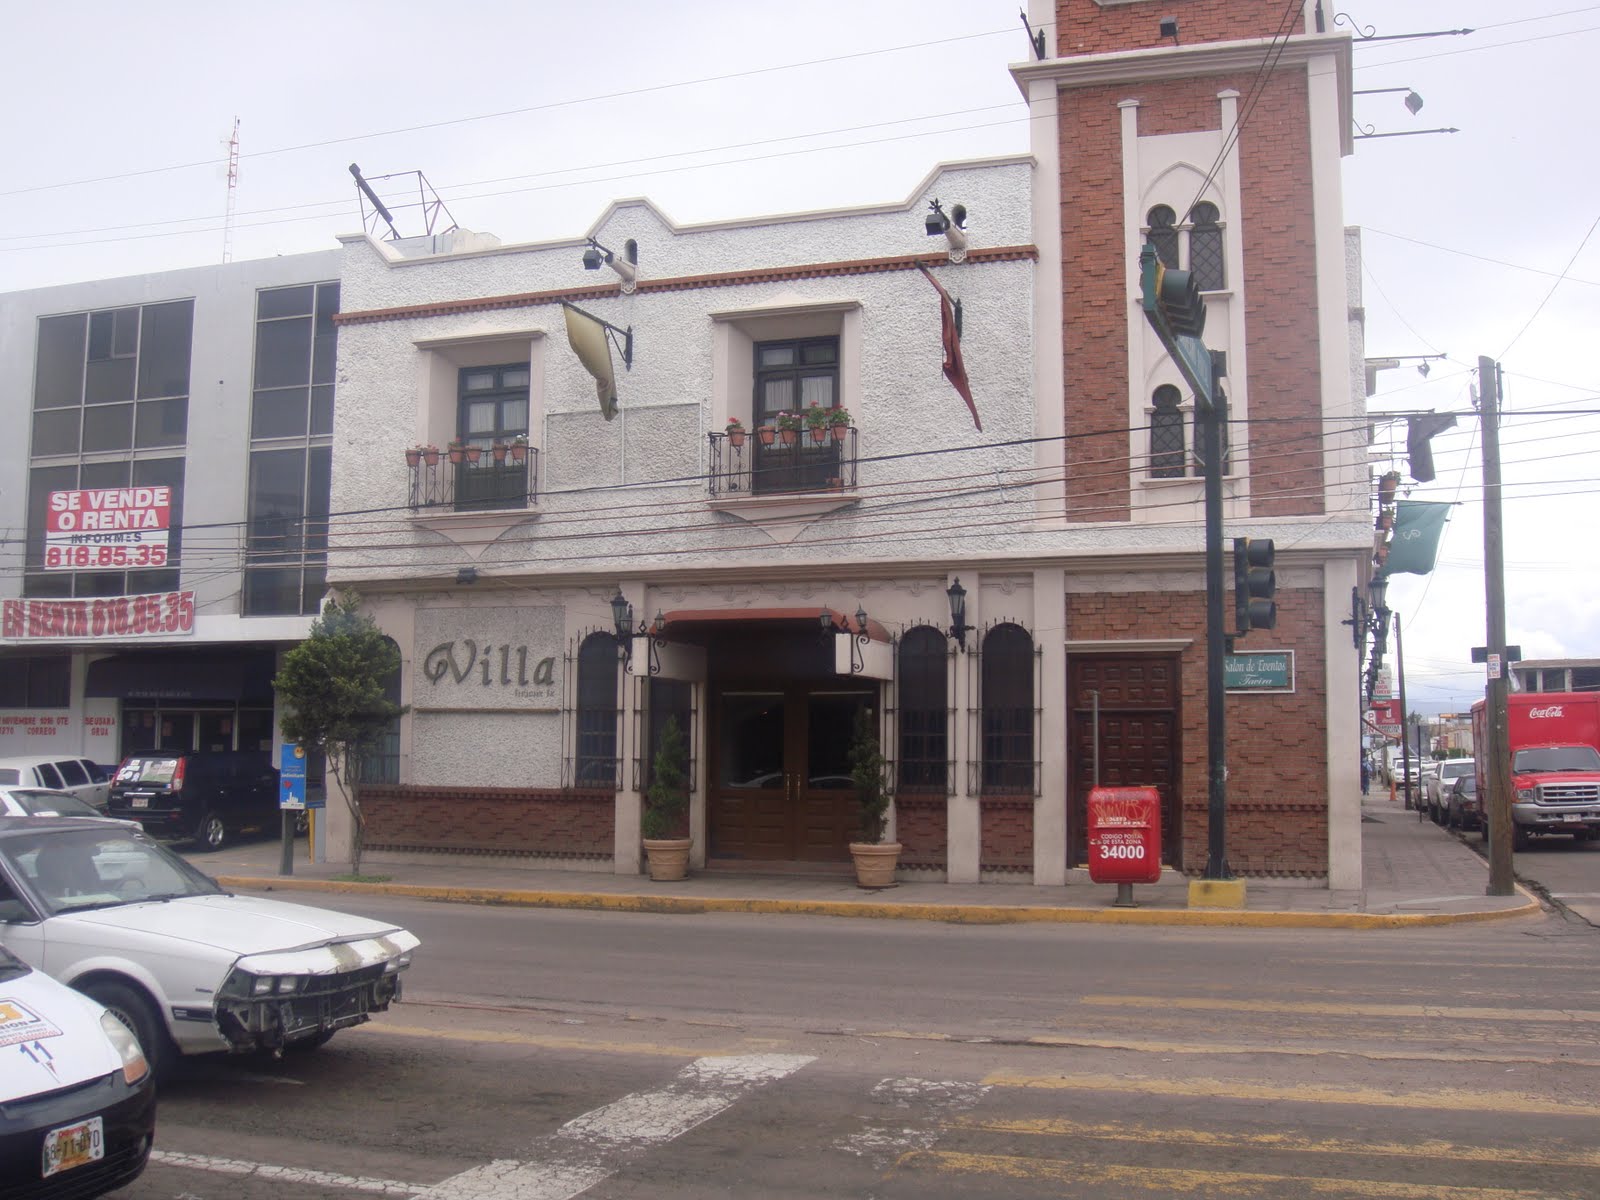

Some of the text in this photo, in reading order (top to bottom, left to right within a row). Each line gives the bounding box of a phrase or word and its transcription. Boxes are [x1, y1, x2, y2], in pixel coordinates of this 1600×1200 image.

[51, 488, 169, 511] SE VENDE
[58, 509, 159, 530] O RENTA
[71, 532, 142, 544] INFORMES
[47, 544, 166, 567] 818.85.35
[2, 590, 194, 637] EN RENTA 818.85.35
[423, 638, 556, 687] Villa
[1246, 658, 1255, 672] de
[1258, 659, 1286, 672] Eventos
[1238, 673, 1273, 686] Tavira
[27, 727, 57, 736] CORREOS
[1100, 845, 1145, 859] 34000
